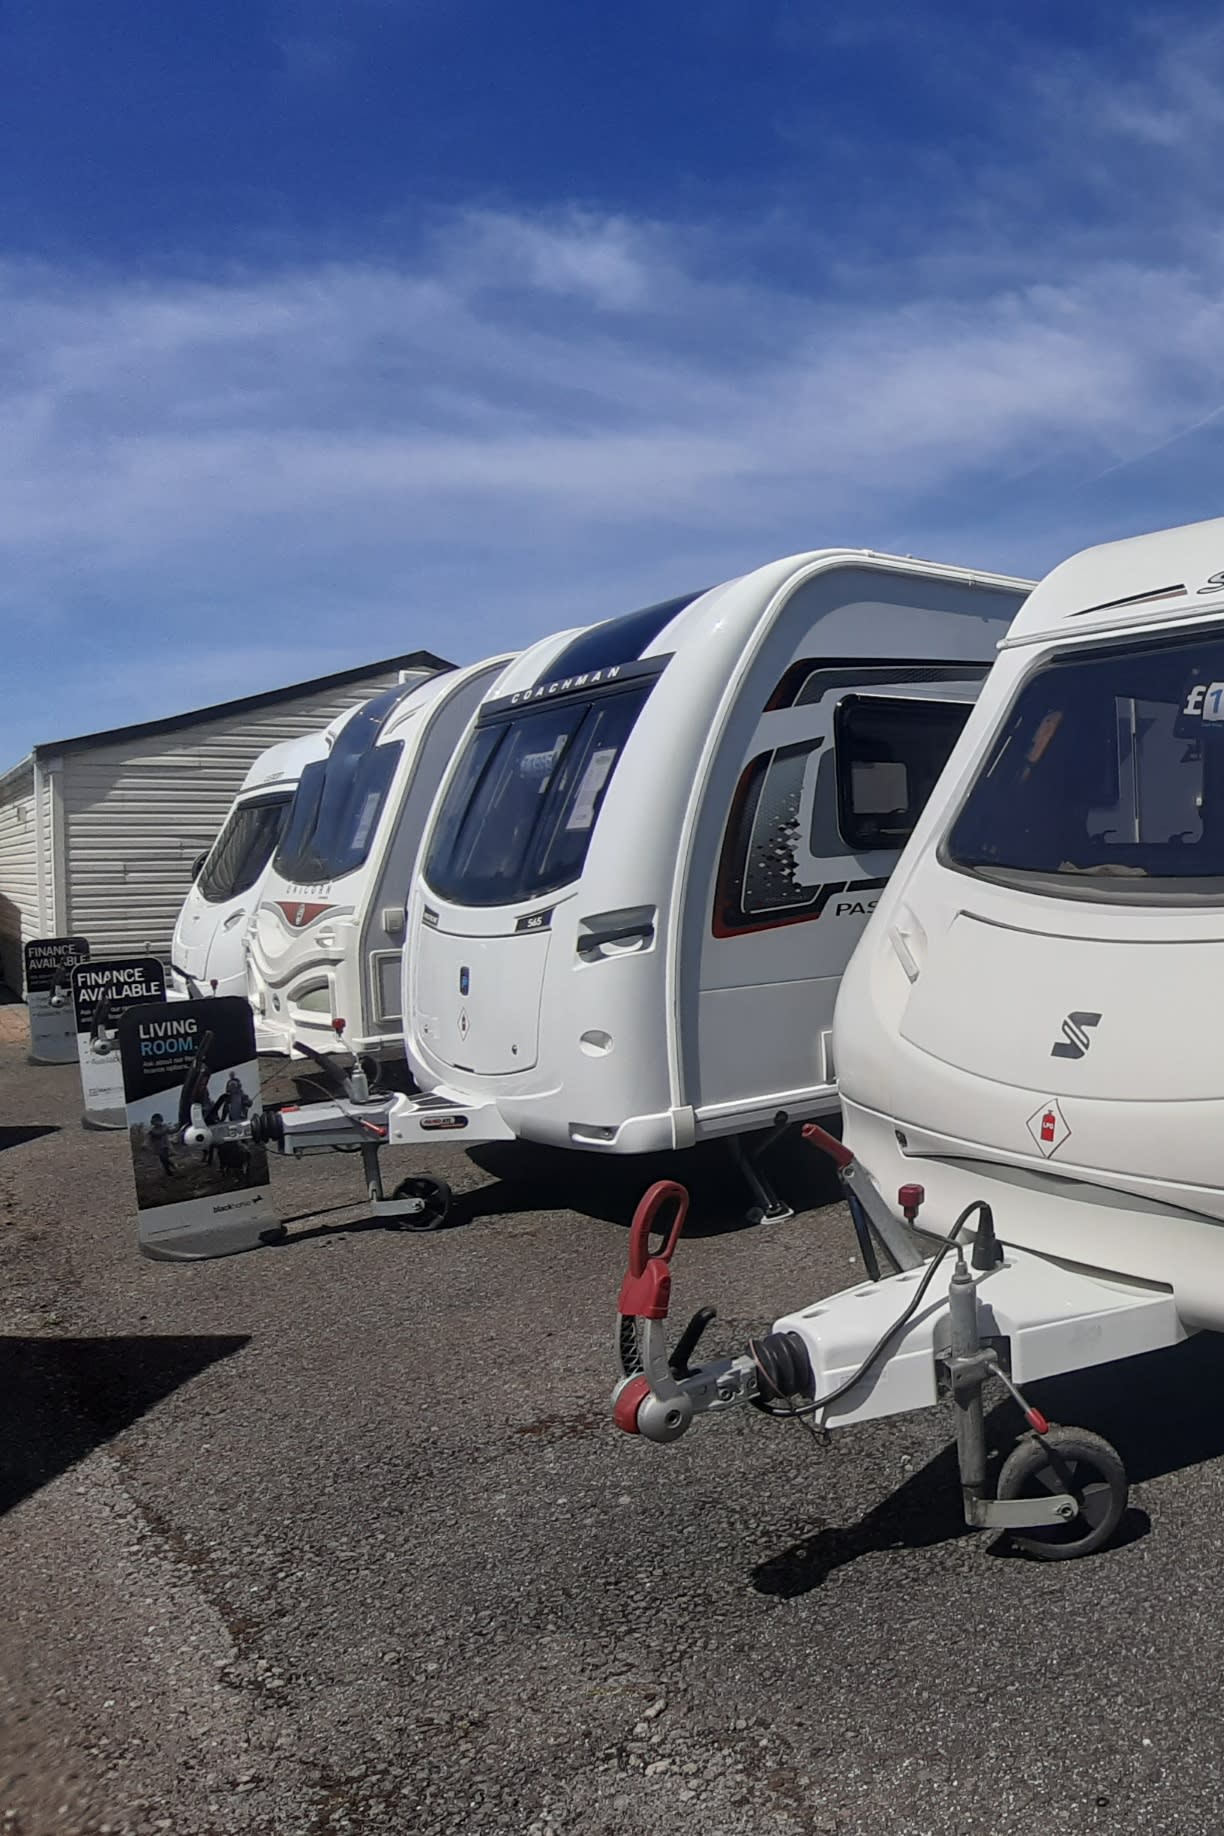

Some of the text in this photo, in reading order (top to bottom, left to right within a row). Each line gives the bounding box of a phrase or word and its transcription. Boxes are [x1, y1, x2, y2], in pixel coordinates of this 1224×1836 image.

[511, 666, 620, 704] COACHMAN
[527, 916, 543, 928] 565
[28, 944, 76, 958] FINANCE
[77, 967, 144, 987] FINANCE
[139, 1018, 198, 1039] LIVING
